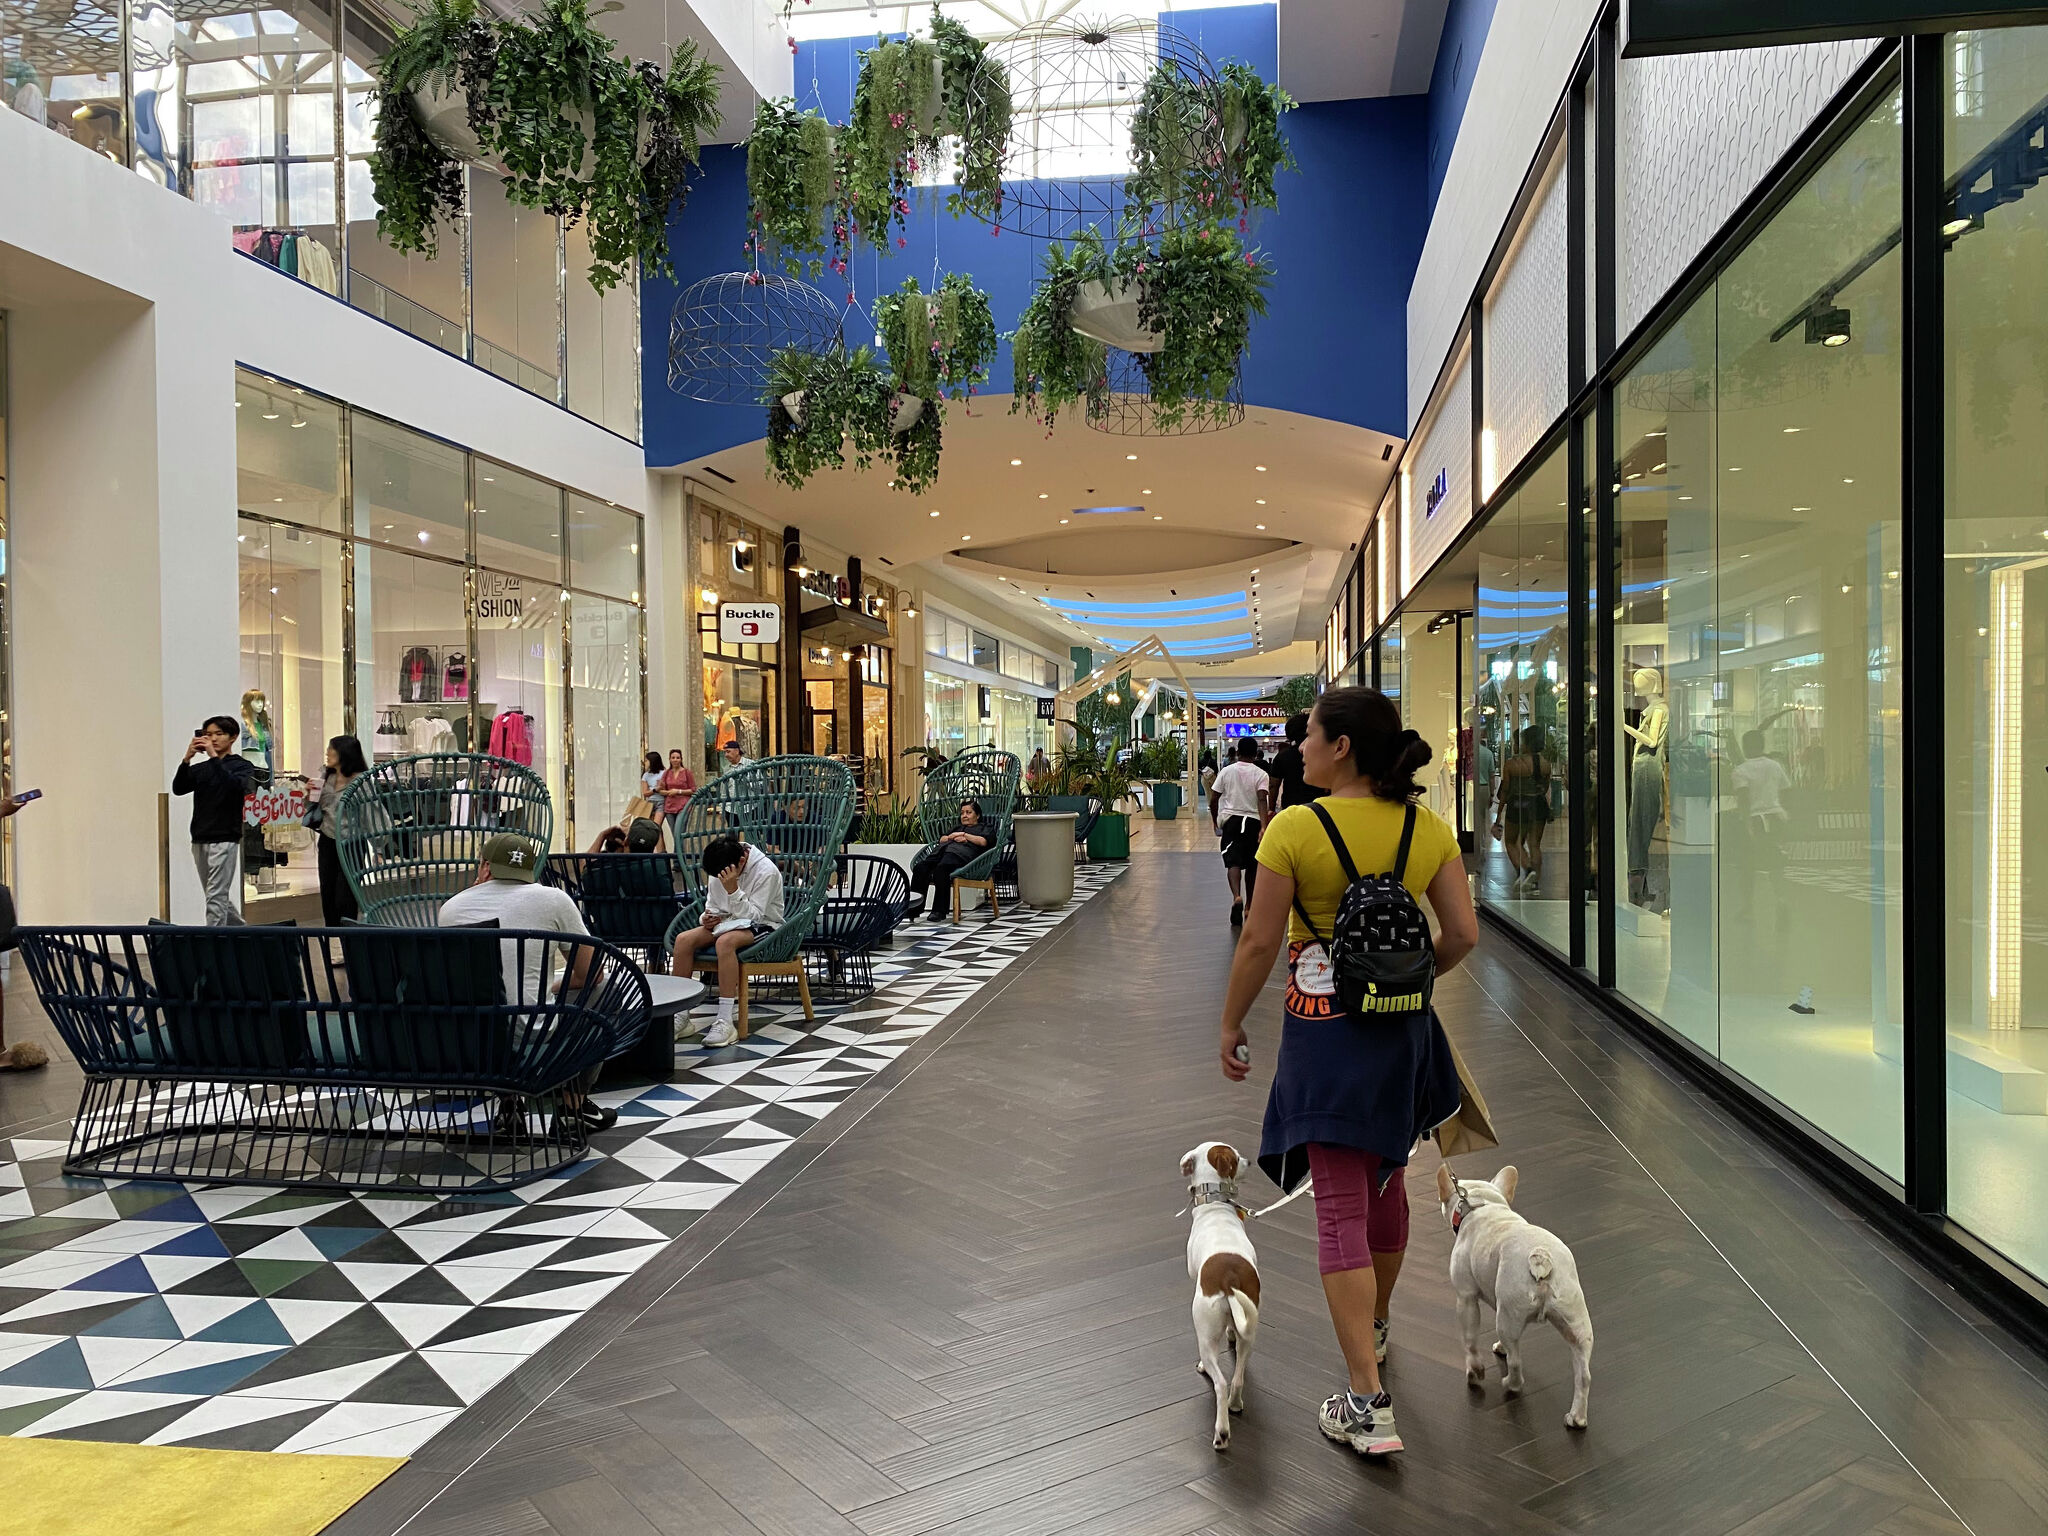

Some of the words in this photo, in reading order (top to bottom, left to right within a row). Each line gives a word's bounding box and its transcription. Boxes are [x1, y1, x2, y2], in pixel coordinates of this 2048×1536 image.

[725, 609, 775, 619] Buckle
[1041, 704, 1054, 715] GAP
[1221, 708, 1252, 718] DOLCE
[1252, 708, 1260, 716] &
